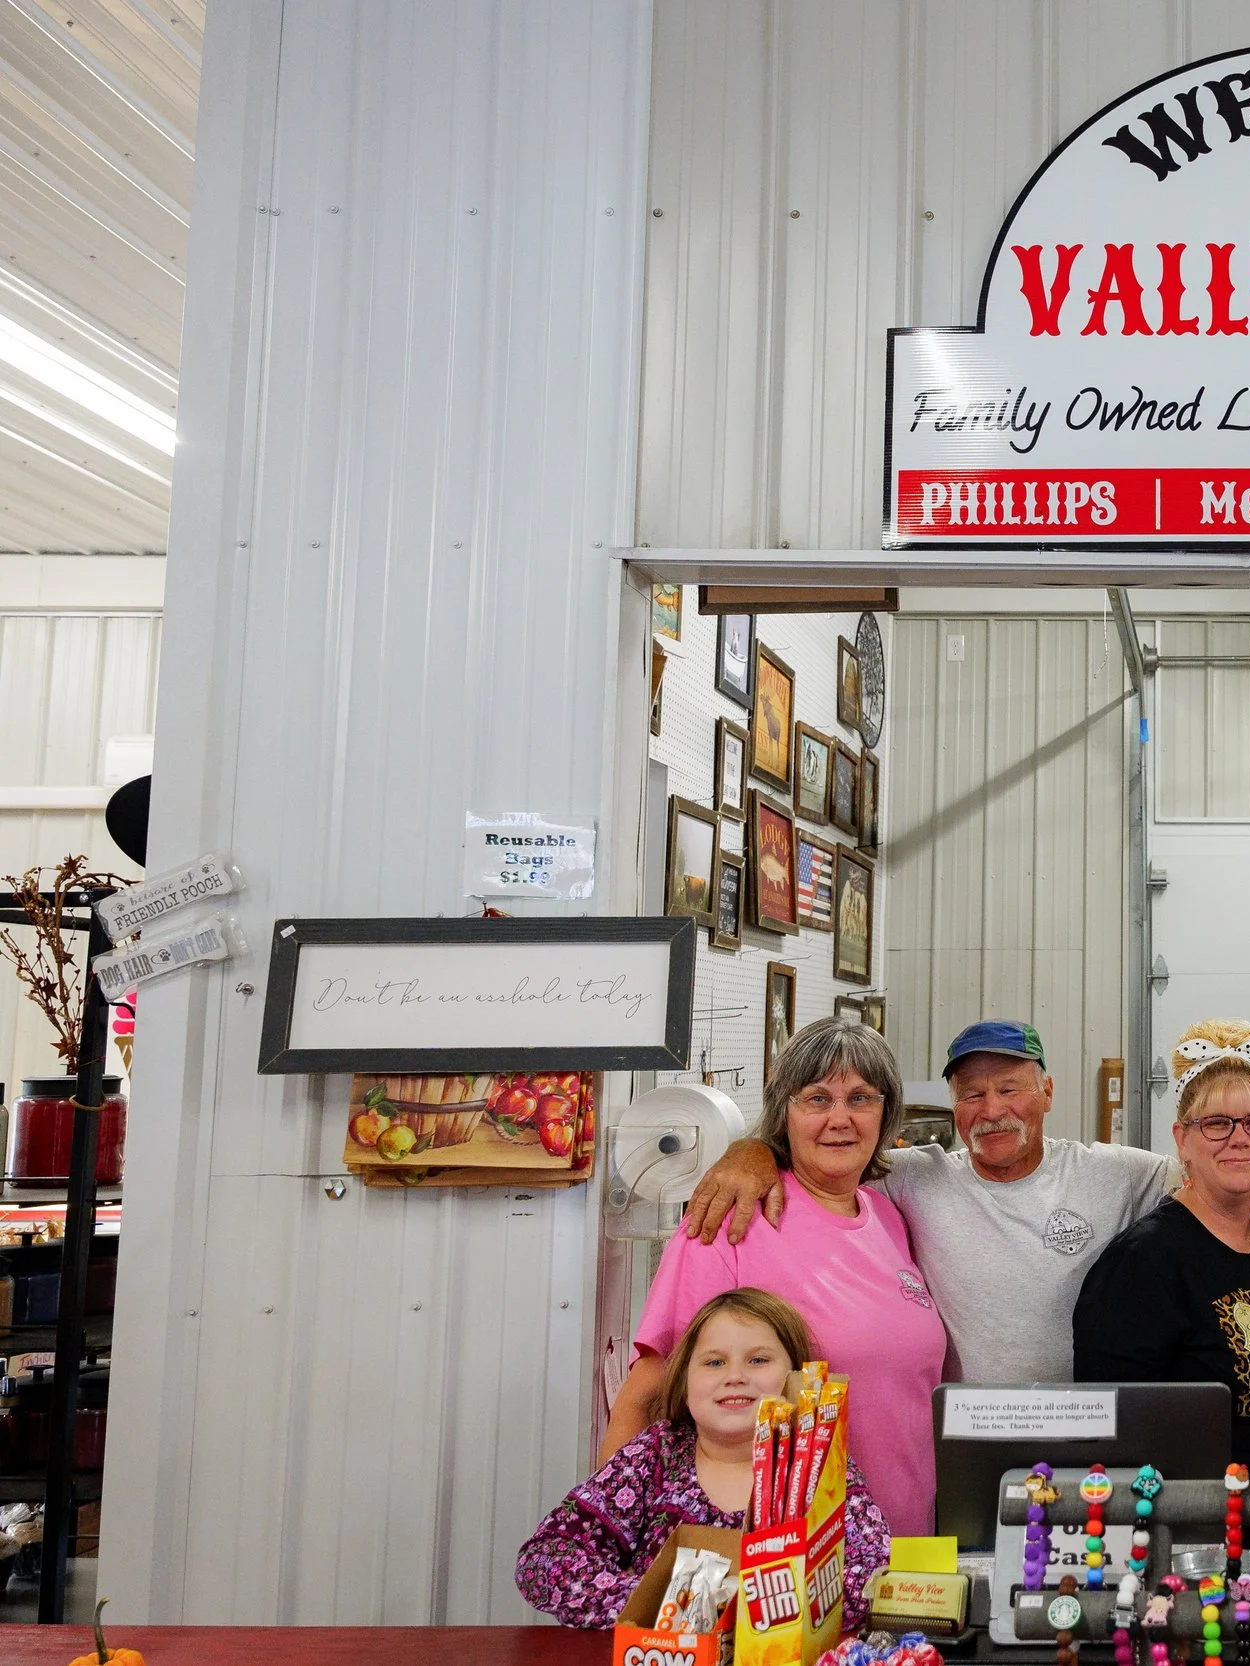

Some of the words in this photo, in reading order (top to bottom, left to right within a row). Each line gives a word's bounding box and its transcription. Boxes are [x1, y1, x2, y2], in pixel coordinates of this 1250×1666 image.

[910, 387, 1050, 455] Family
[1065, 387, 1203, 431] Owned
[920, 480, 1117, 527] PHILLIPS
[485, 833, 576, 847] Reusable
[113, 890, 181, 931] FRIENDLY
[180, 873, 224, 902] POOCH
[99, 963, 125, 989] DOG
[123, 953, 154, 981] HAIR
[400, 978, 428, 1005] be
[438, 994, 469, 1003] an
[475, 977, 571, 1006] asshole
[577, 974, 652, 1019] today
[818, 1404, 838, 1414] slim
[822, 1411, 838, 1423] jim
[953, 1403, 959, 1411] 3
[961, 1403, 970, 1411] %
[973, 1403, 1000, 1411] service
[1002, 1403, 1029, 1412] charge
[1045, 1402, 1054, 1410] all
[1056, 1402, 1080, 1410] credit
[1081, 1402, 1104, 1410] cards
[1065, 1413, 1085, 1421] longer
[817, 1427, 830, 1437] 6g
[788, 1458, 803, 1516] ORIGINAL
[805, 1448, 823, 1504] ORIGINAL
[754, 1467, 763, 1525] ORIGINAL
[746, 1531, 800, 1556] ORIAL
[808, 1518, 843, 1560] ORIGINAL
[743, 1567, 796, 1602] slim
[807, 1555, 840, 1604] slim
[898, 1582, 926, 1597] Valley
[927, 1583, 945, 1595] View
[754, 1590, 801, 1631] jim
[814, 1575, 843, 1628] jim
[641, 1637, 677, 1647] CARAMEL
